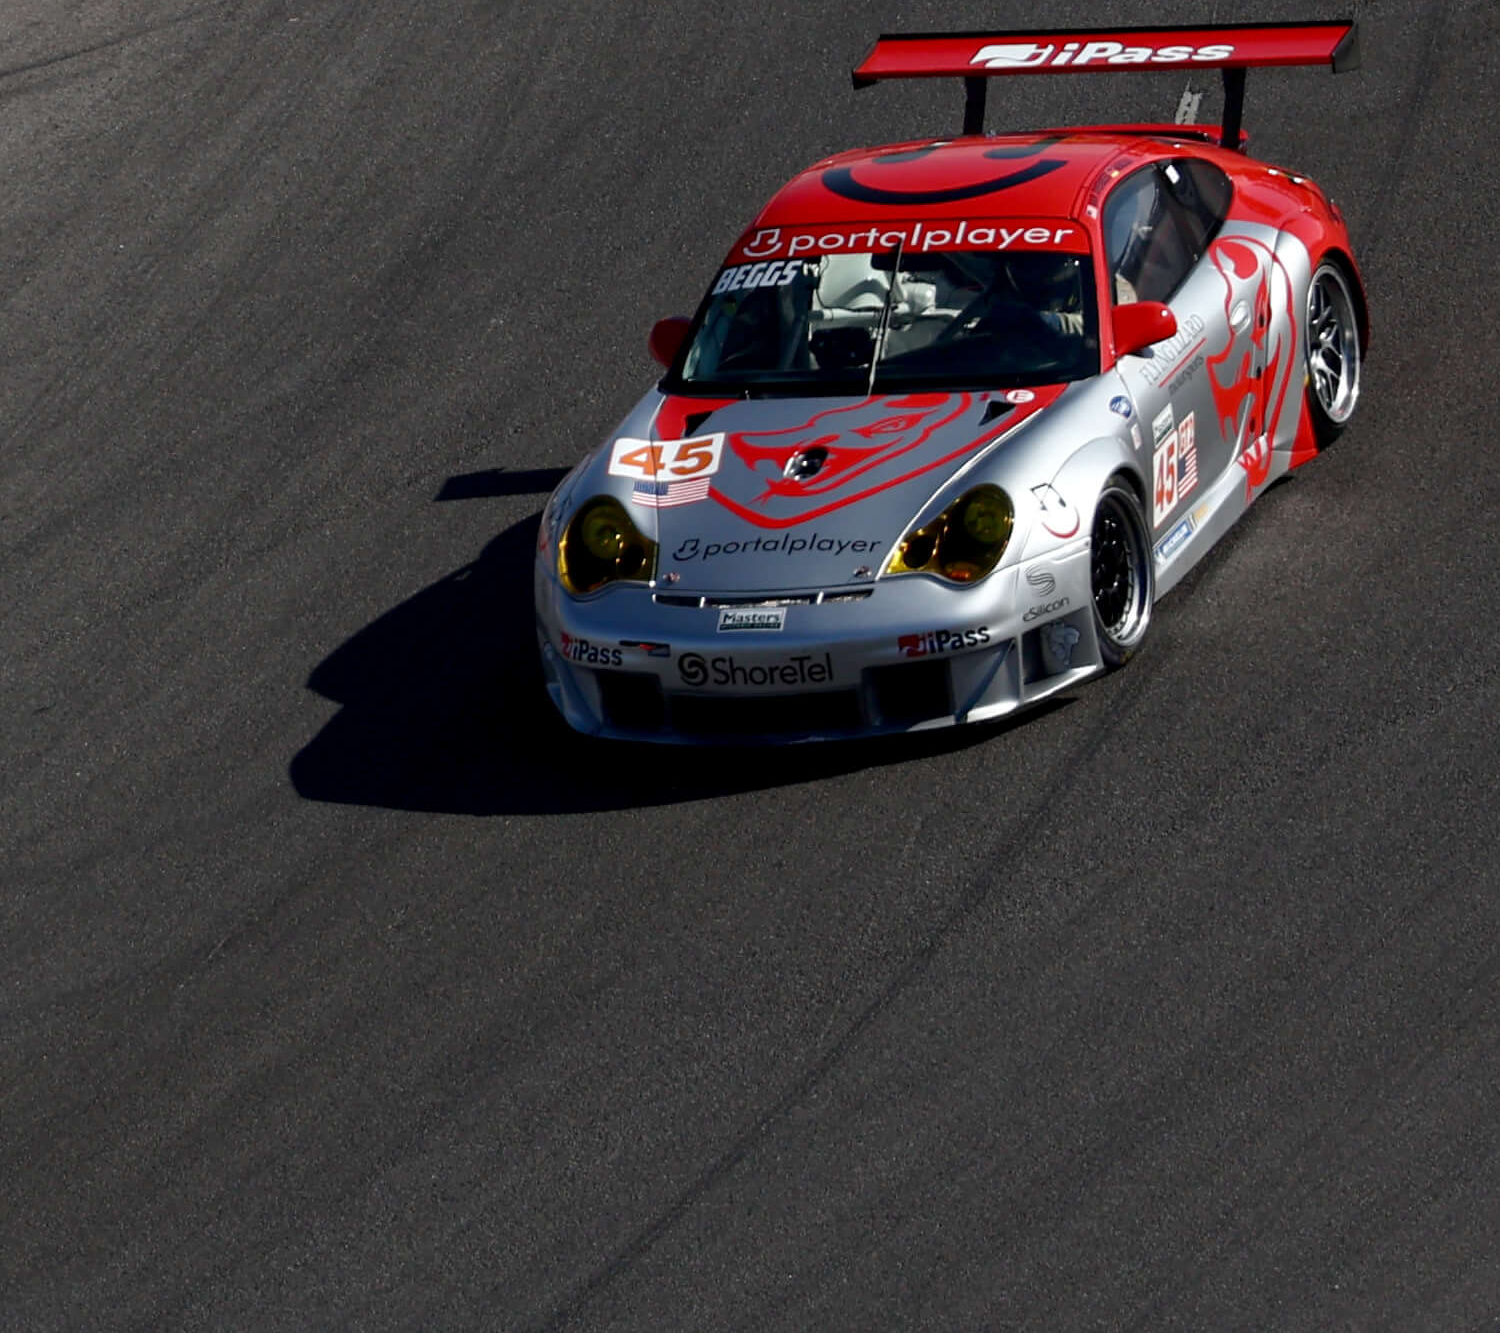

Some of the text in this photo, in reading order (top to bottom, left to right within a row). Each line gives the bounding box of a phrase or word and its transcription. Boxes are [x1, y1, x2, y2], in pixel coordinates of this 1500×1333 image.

[1050, 41, 1235, 66] iPass
[786, 221, 1075, 256] portalplayer
[710, 259, 804, 297] BEGGS
[618, 438, 715, 477] 45
[1155, 442, 1176, 513] 45
[701, 532, 882, 561] portalplayer
[722, 611, 781, 624] Masters
[572, 636, 624, 667] iPass
[926, 625, 991, 654] iPass
[711, 652, 834, 686] ShoreTel
